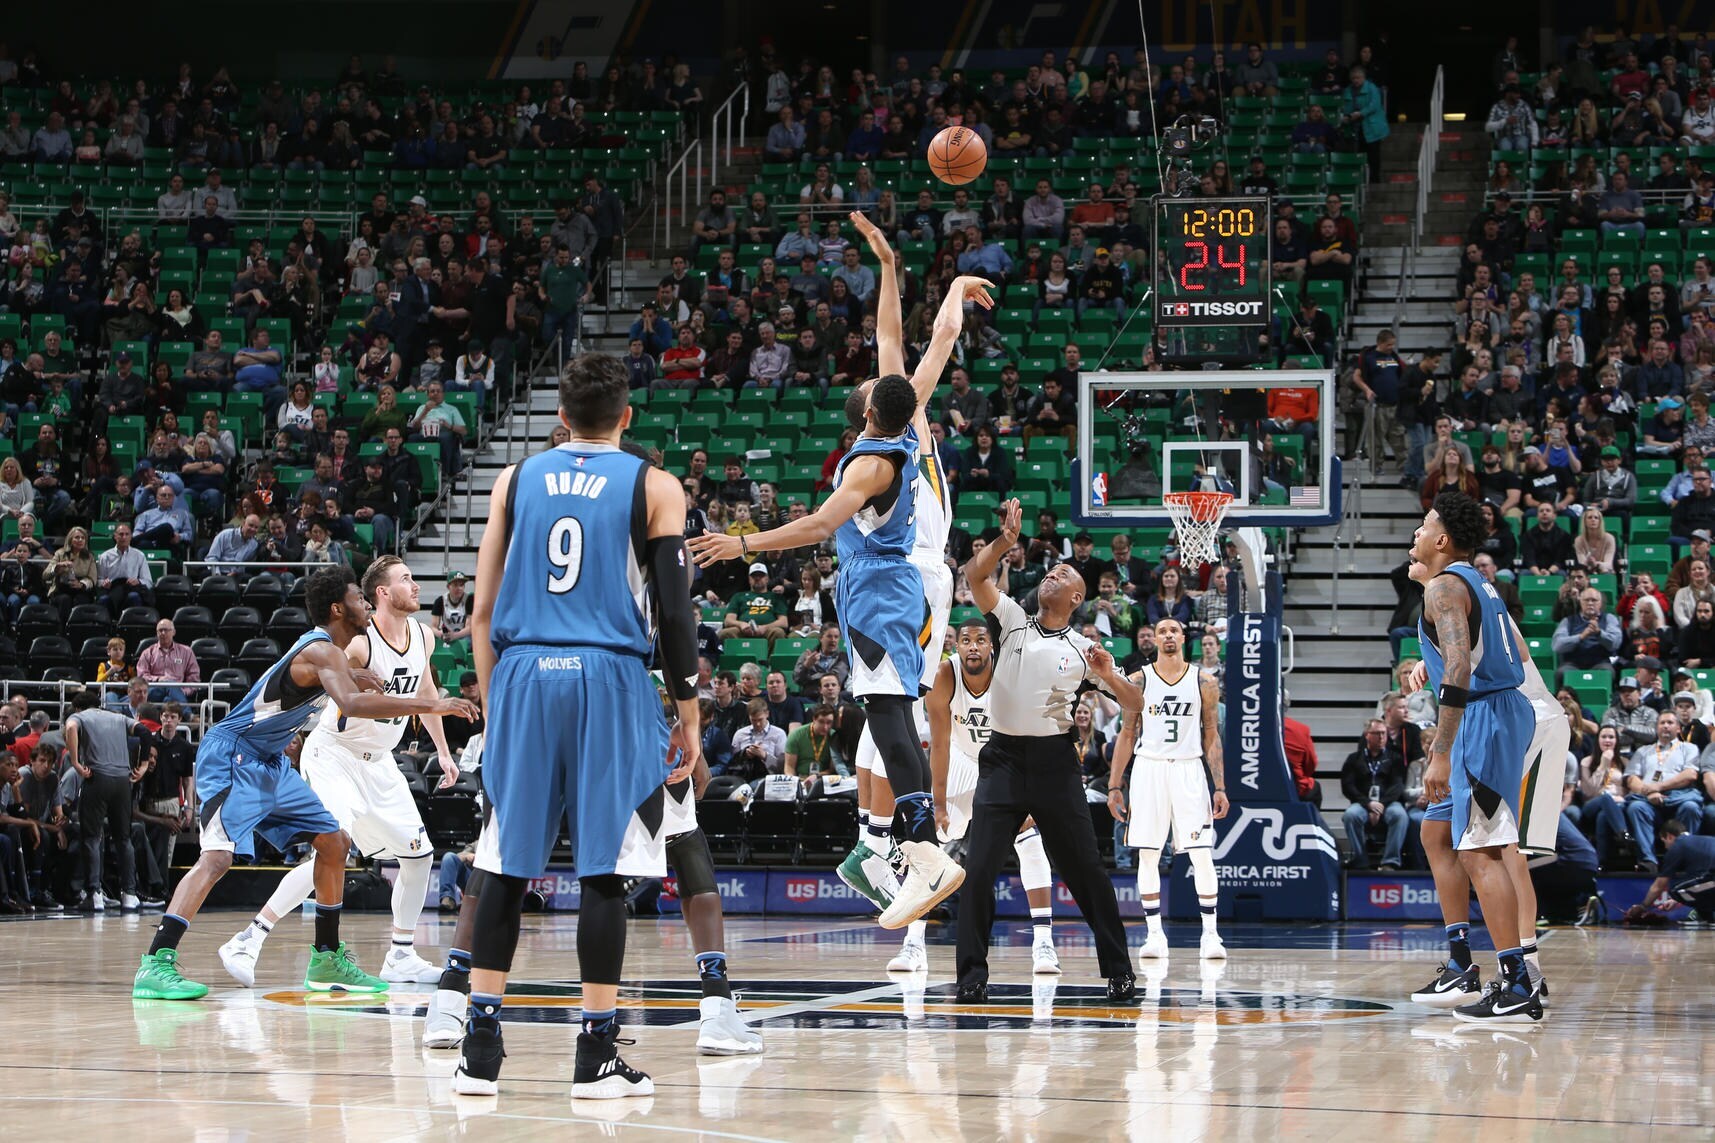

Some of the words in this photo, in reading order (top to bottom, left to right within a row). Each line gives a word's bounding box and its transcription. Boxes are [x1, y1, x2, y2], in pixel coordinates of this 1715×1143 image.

[1161, 0, 1307, 52] UTAH
[1592, 0, 1715, 44] JAZ
[1184, 209, 1254, 237] 12:00
[1181, 241, 1245, 290] 24
[1190, 301, 1263, 316] TISSOT
[545, 471, 608, 499] RUBIO
[546, 515, 584, 595] 9
[748, 606, 770, 615] 27
[1242, 615, 1262, 679] FIRST
[539, 656, 582, 671] WOLVES
[383, 667, 419, 695] JAZZ
[954, 707, 991, 727] JAZ
[1148, 695, 1194, 717] JAZZ
[967, 728, 992, 744] 15
[1164, 719, 1178, 743] 3
[1240, 683, 1260, 790] AMERICA
[1185, 866, 1260, 879] AERICA
[1263, 866, 1311, 879] FIRST
